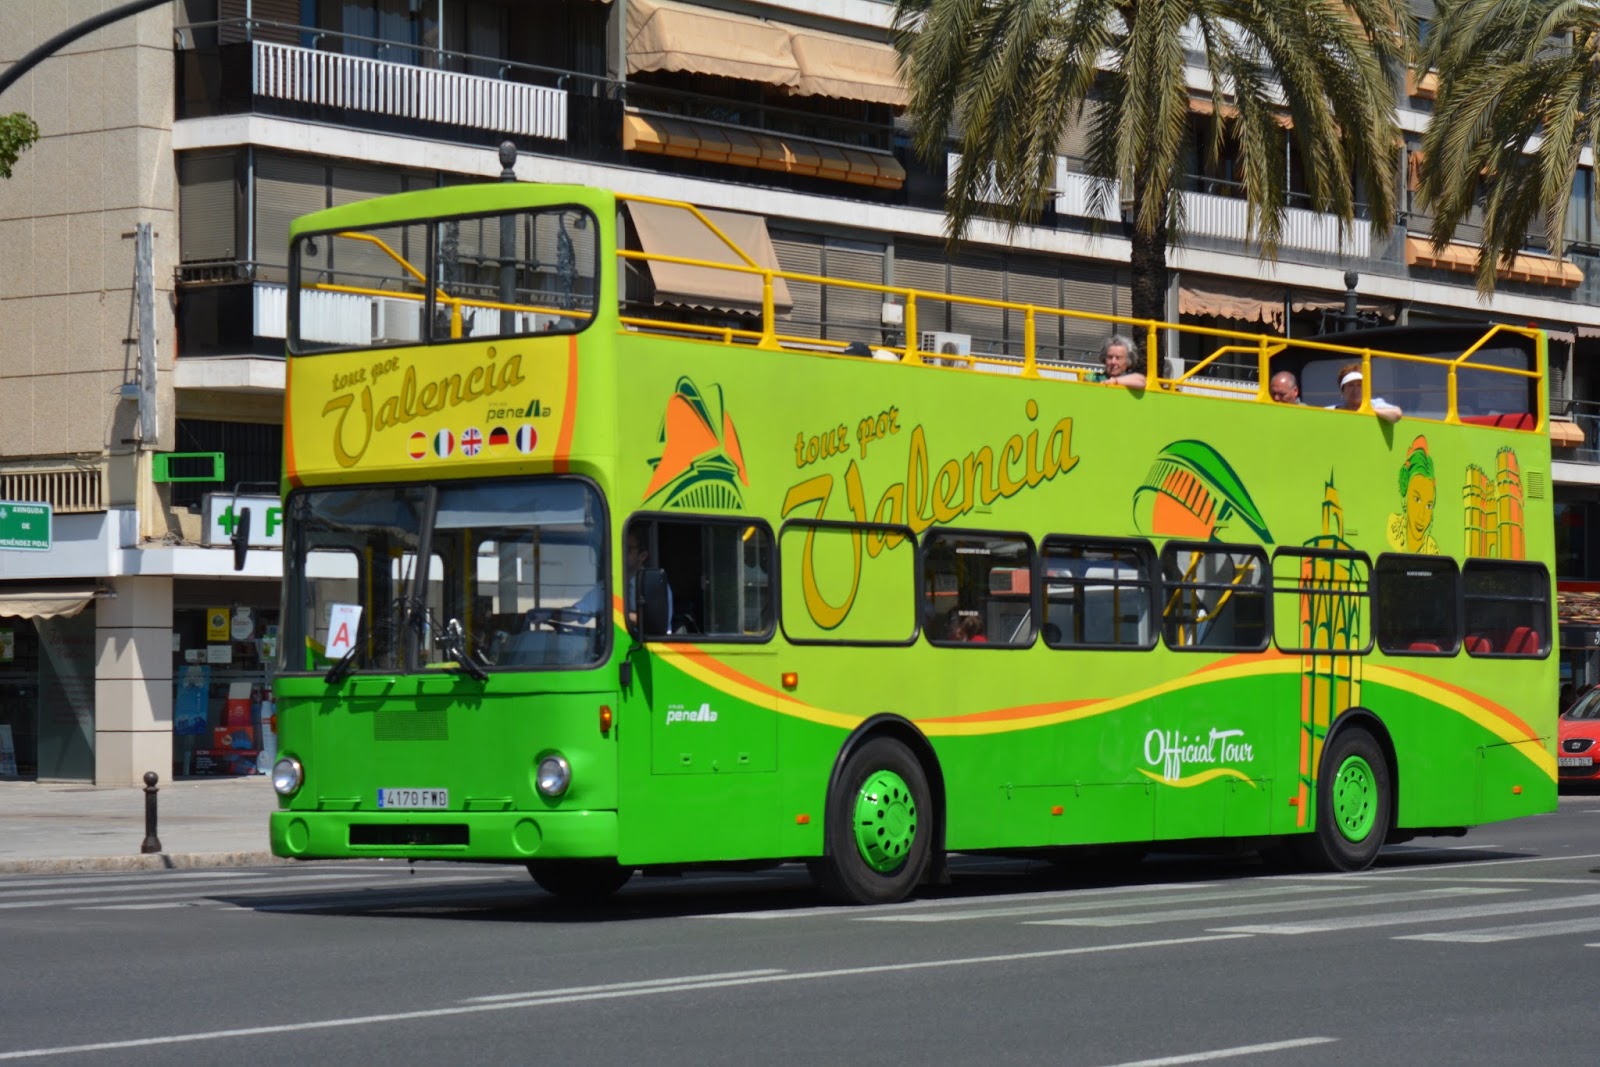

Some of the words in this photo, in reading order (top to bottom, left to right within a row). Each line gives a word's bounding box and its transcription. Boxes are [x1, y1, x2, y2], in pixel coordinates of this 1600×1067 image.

[332, 369, 366, 392] tour
[371, 356, 400, 385] por
[321, 346, 525, 468] Valencia
[794, 423, 850, 468] tour
[857, 405, 901, 460] por
[12, 506, 44, 514] AVINGUDA
[21, 522, 31, 530] DE
[781, 399, 1080, 630] Valencia
[32, 540, 49, 548] PIDAL
[332, 622, 350, 648] A
[1144, 727, 1216, 781] Official
[1209, 729, 1255, 764] Tour
